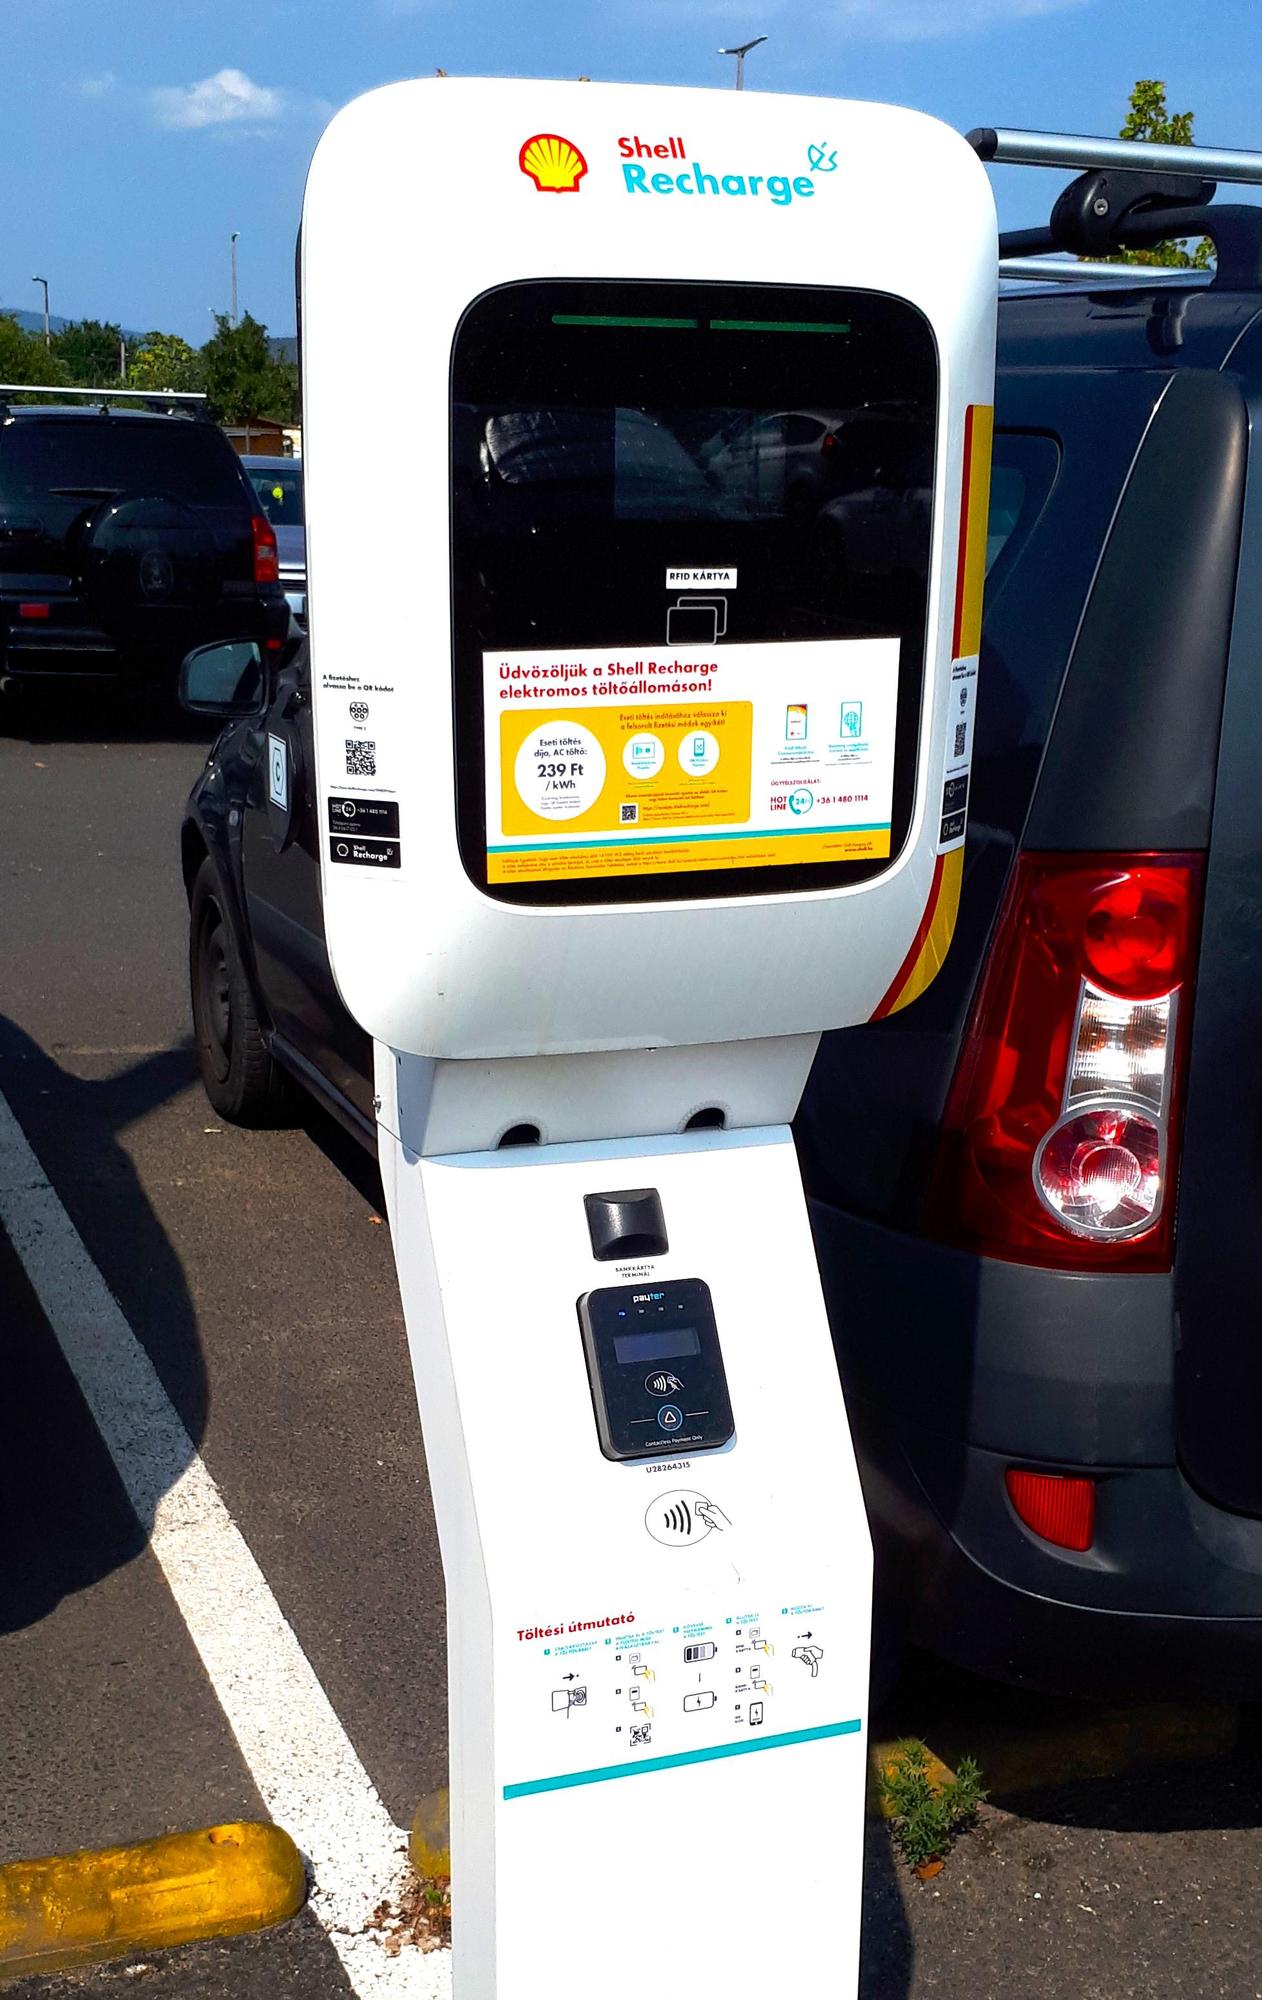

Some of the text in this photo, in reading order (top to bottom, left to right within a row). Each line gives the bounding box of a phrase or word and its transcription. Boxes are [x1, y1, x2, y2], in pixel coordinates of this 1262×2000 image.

[618, 136, 686, 159] Shell
[622, 162, 814, 206] Recharge
[670, 570, 730, 580] RFID KÁRTYA
[500, 661, 718, 681] Üdvözöljük a Shell Recharge
[500, 680, 712, 698] elektromos töltőállomáson!
[537, 763, 584, 778] 239 Ft
[553, 780, 576, 790] kWh
[353, 851, 388, 862] Recharge
[633, 1292, 664, 1303] payter
[646, 1462, 690, 1473] U28264315
[517, 1611, 635, 1641] Töltési útmutató
